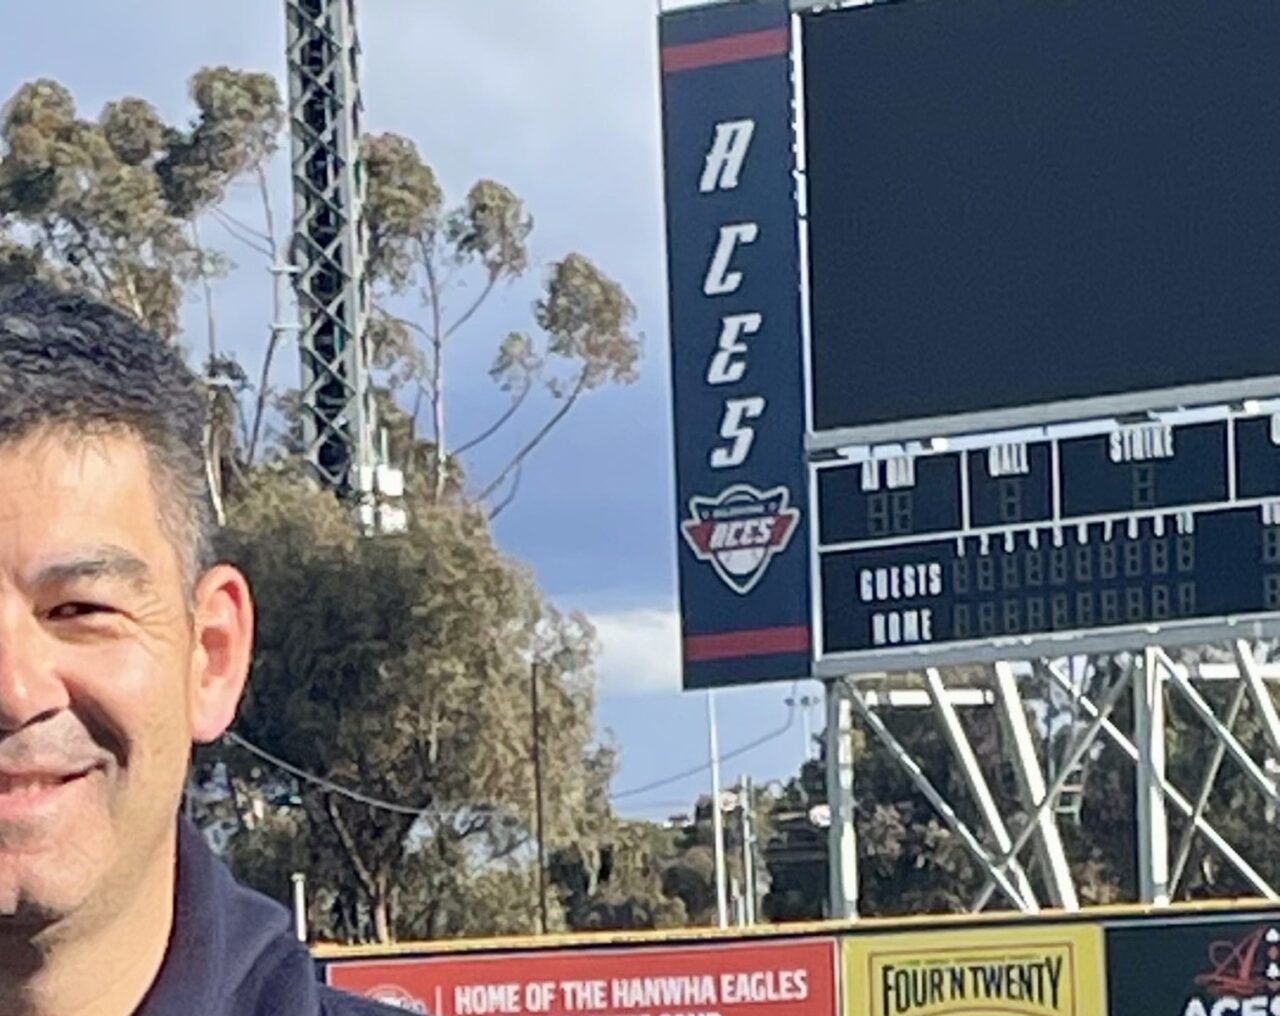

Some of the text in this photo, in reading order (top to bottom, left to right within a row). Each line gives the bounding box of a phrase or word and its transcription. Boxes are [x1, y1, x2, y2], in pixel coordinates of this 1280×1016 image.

[699, 119, 765, 468] ACES
[860, 562, 942, 602] GUESTS
[872, 609, 932, 645] HOME
[454, 983, 521, 1015] HOME
[524, 981, 556, 1012] OF
[559, 978, 609, 1010] THE
[611, 974, 716, 1009] HANWHA
[720, 968, 808, 1004] EAGLES
[968, 956, 1062, 1010] TWENTY
